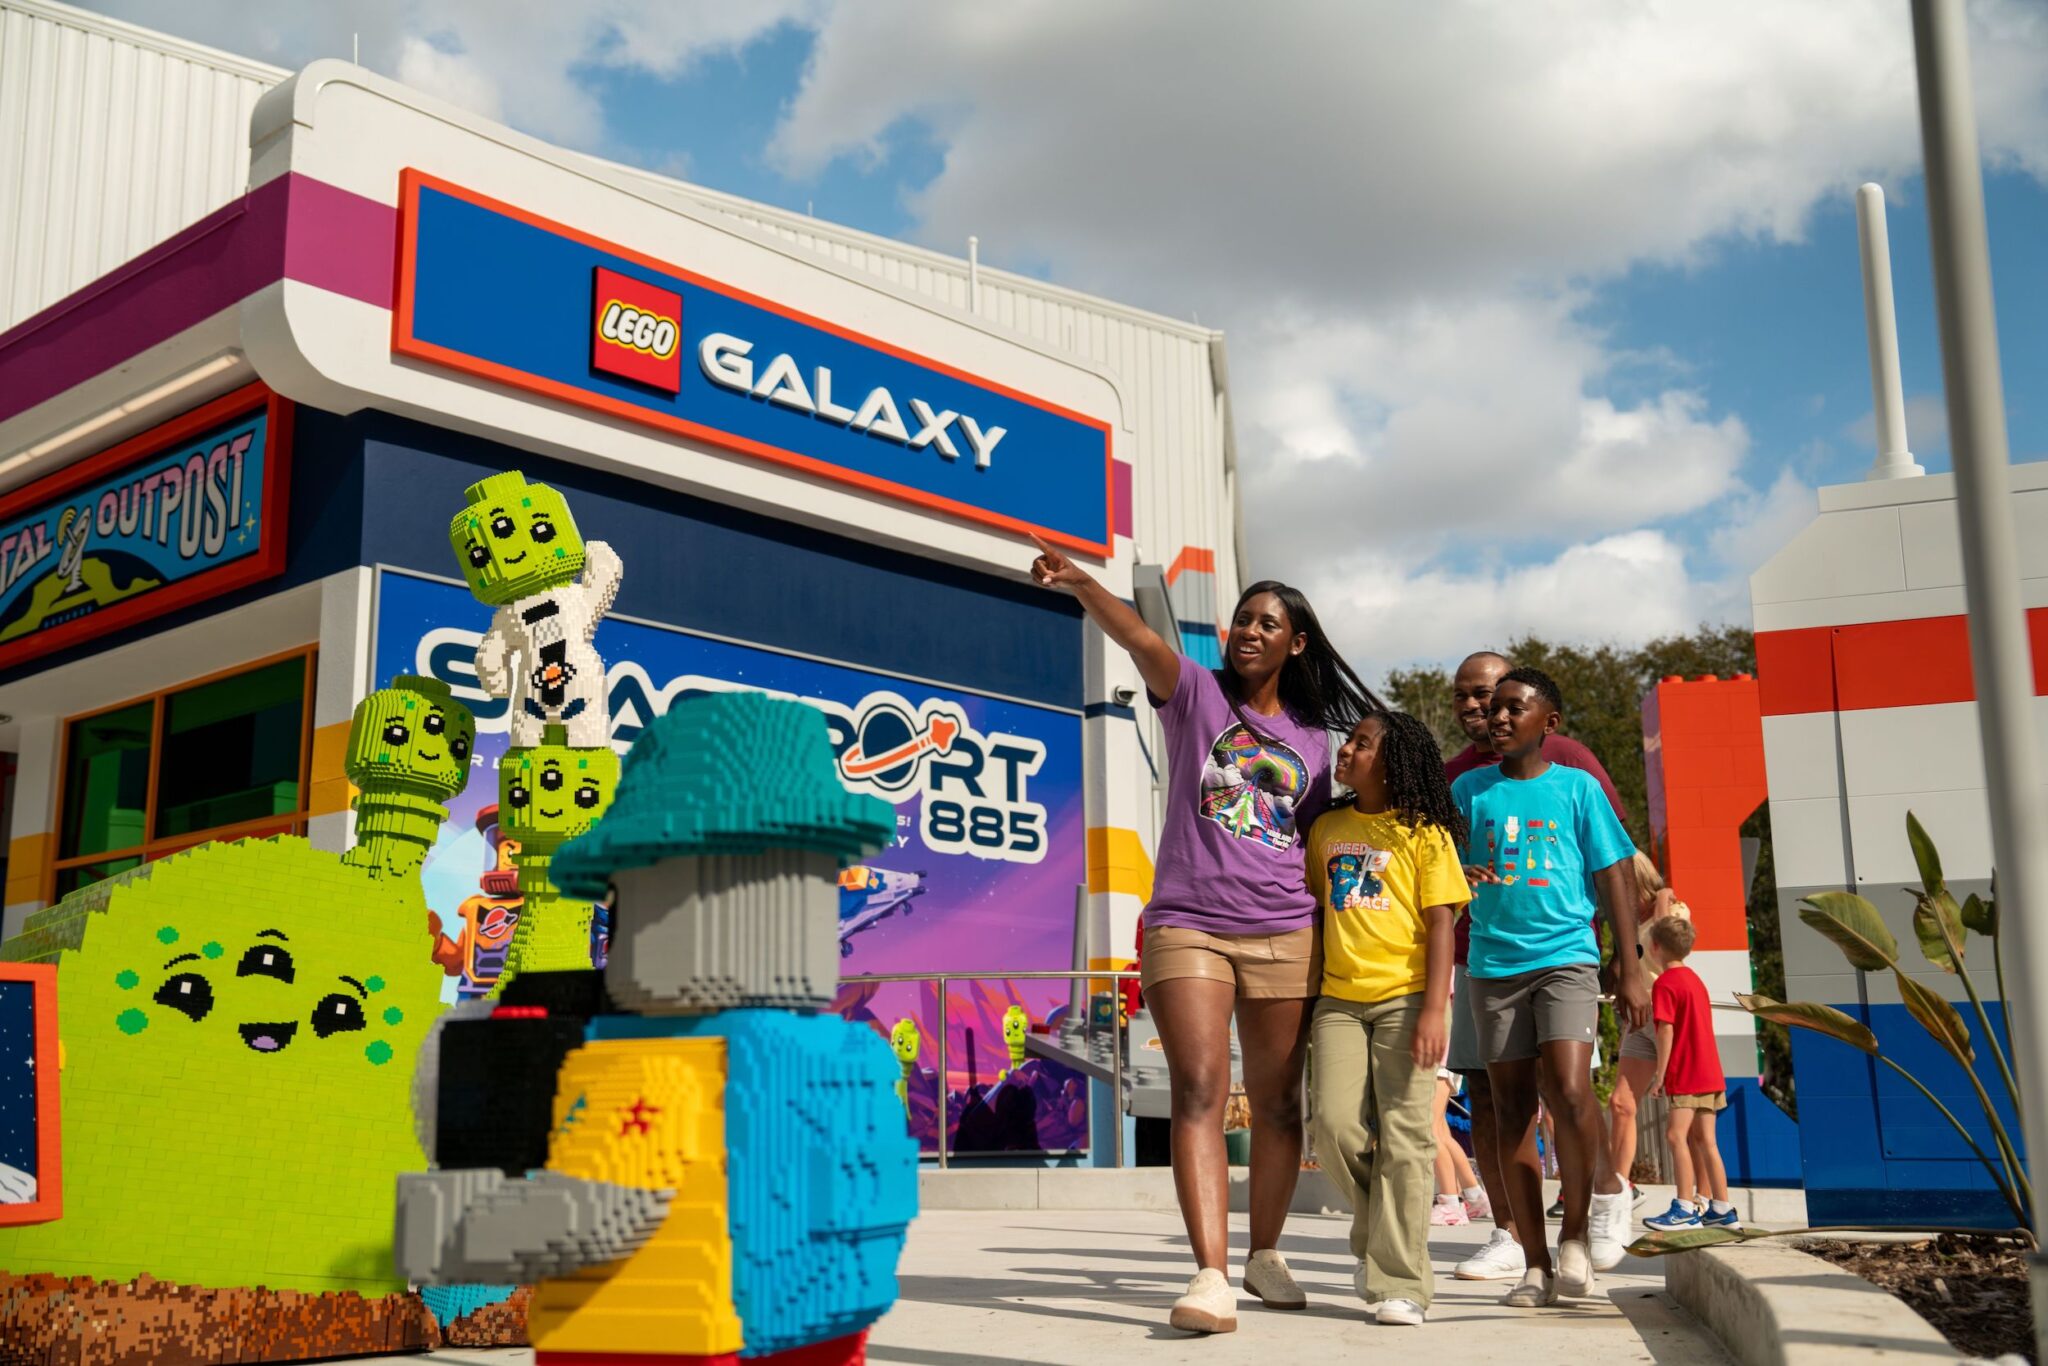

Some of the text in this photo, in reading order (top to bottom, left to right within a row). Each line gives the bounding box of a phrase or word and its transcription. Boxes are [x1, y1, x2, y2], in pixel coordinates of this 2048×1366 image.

[600, 301, 1007, 467] LEGO GALAXY
[96, 429, 255, 559] OUTPOST
[929, 800, 1040, 852] 885
[1333, 842, 1369, 855] NEED
[1344, 894, 1390, 911] SPACE
